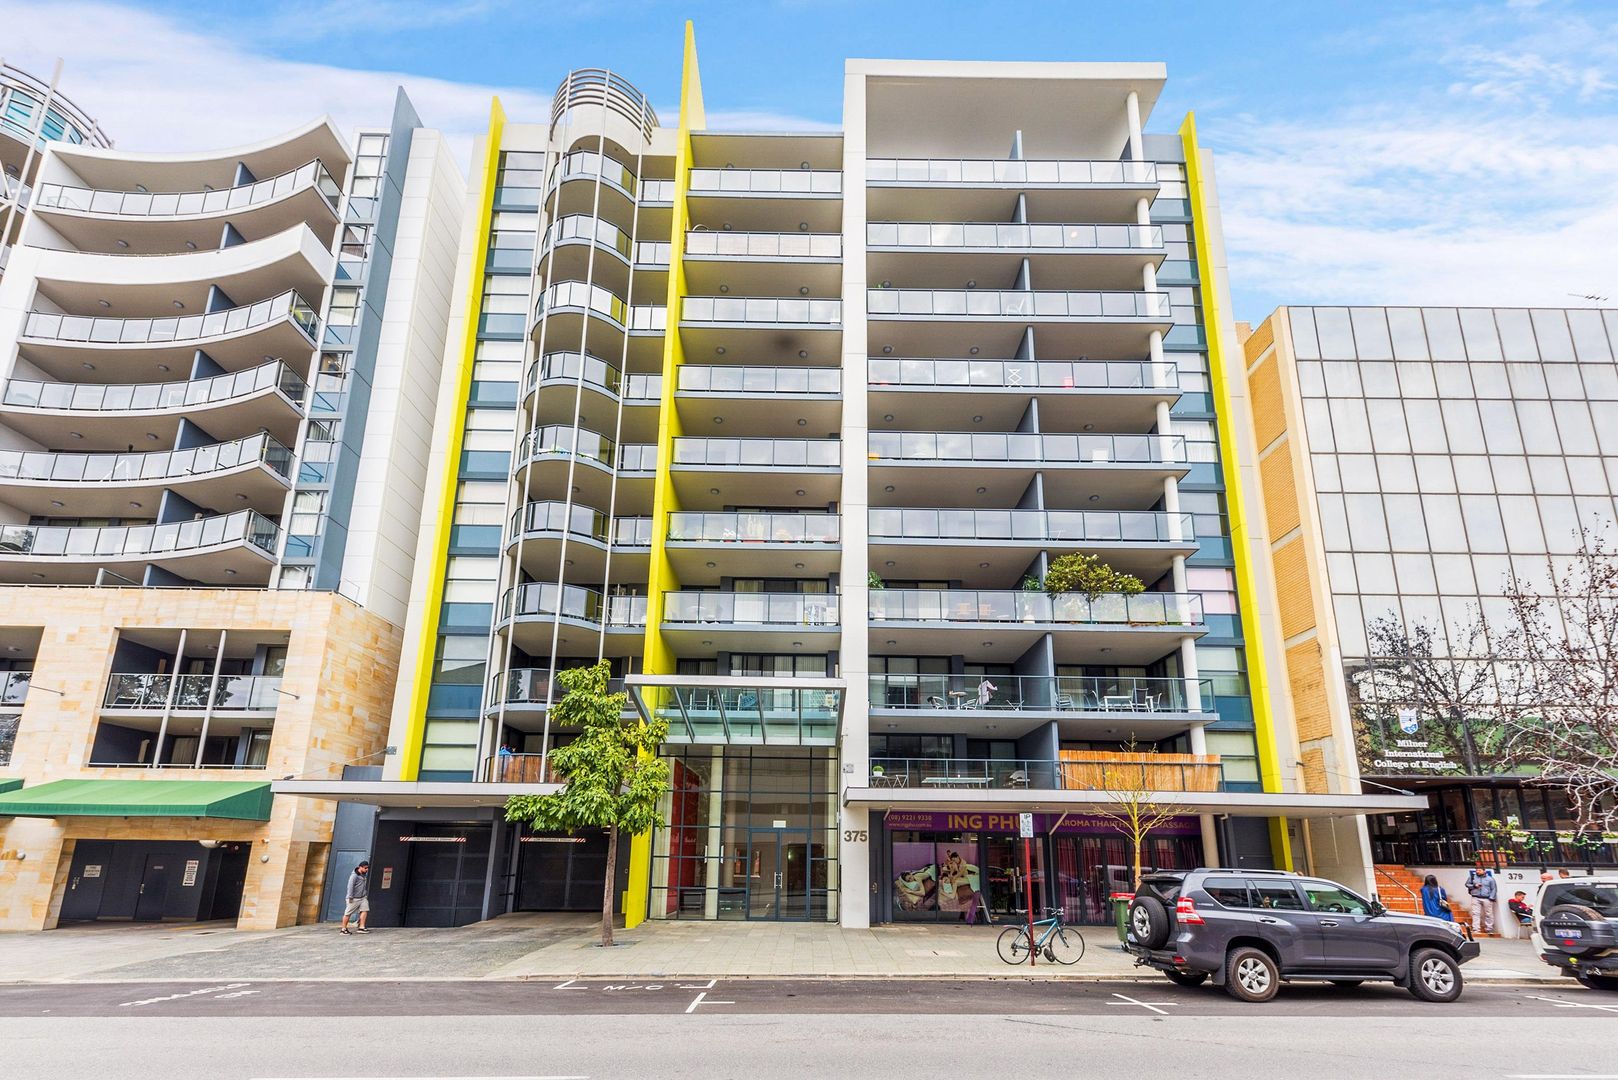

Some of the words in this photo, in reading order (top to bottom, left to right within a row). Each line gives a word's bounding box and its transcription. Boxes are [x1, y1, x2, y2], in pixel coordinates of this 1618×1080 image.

[1384, 750, 1444, 758] International
[1374, 760, 1408, 769] College
[1410, 760, 1421, 768] of
[1421, 761, 1457, 770] English
[888, 814, 901, 822] (08)
[948, 815, 983, 829] ING
[844, 831, 867, 842] 375
